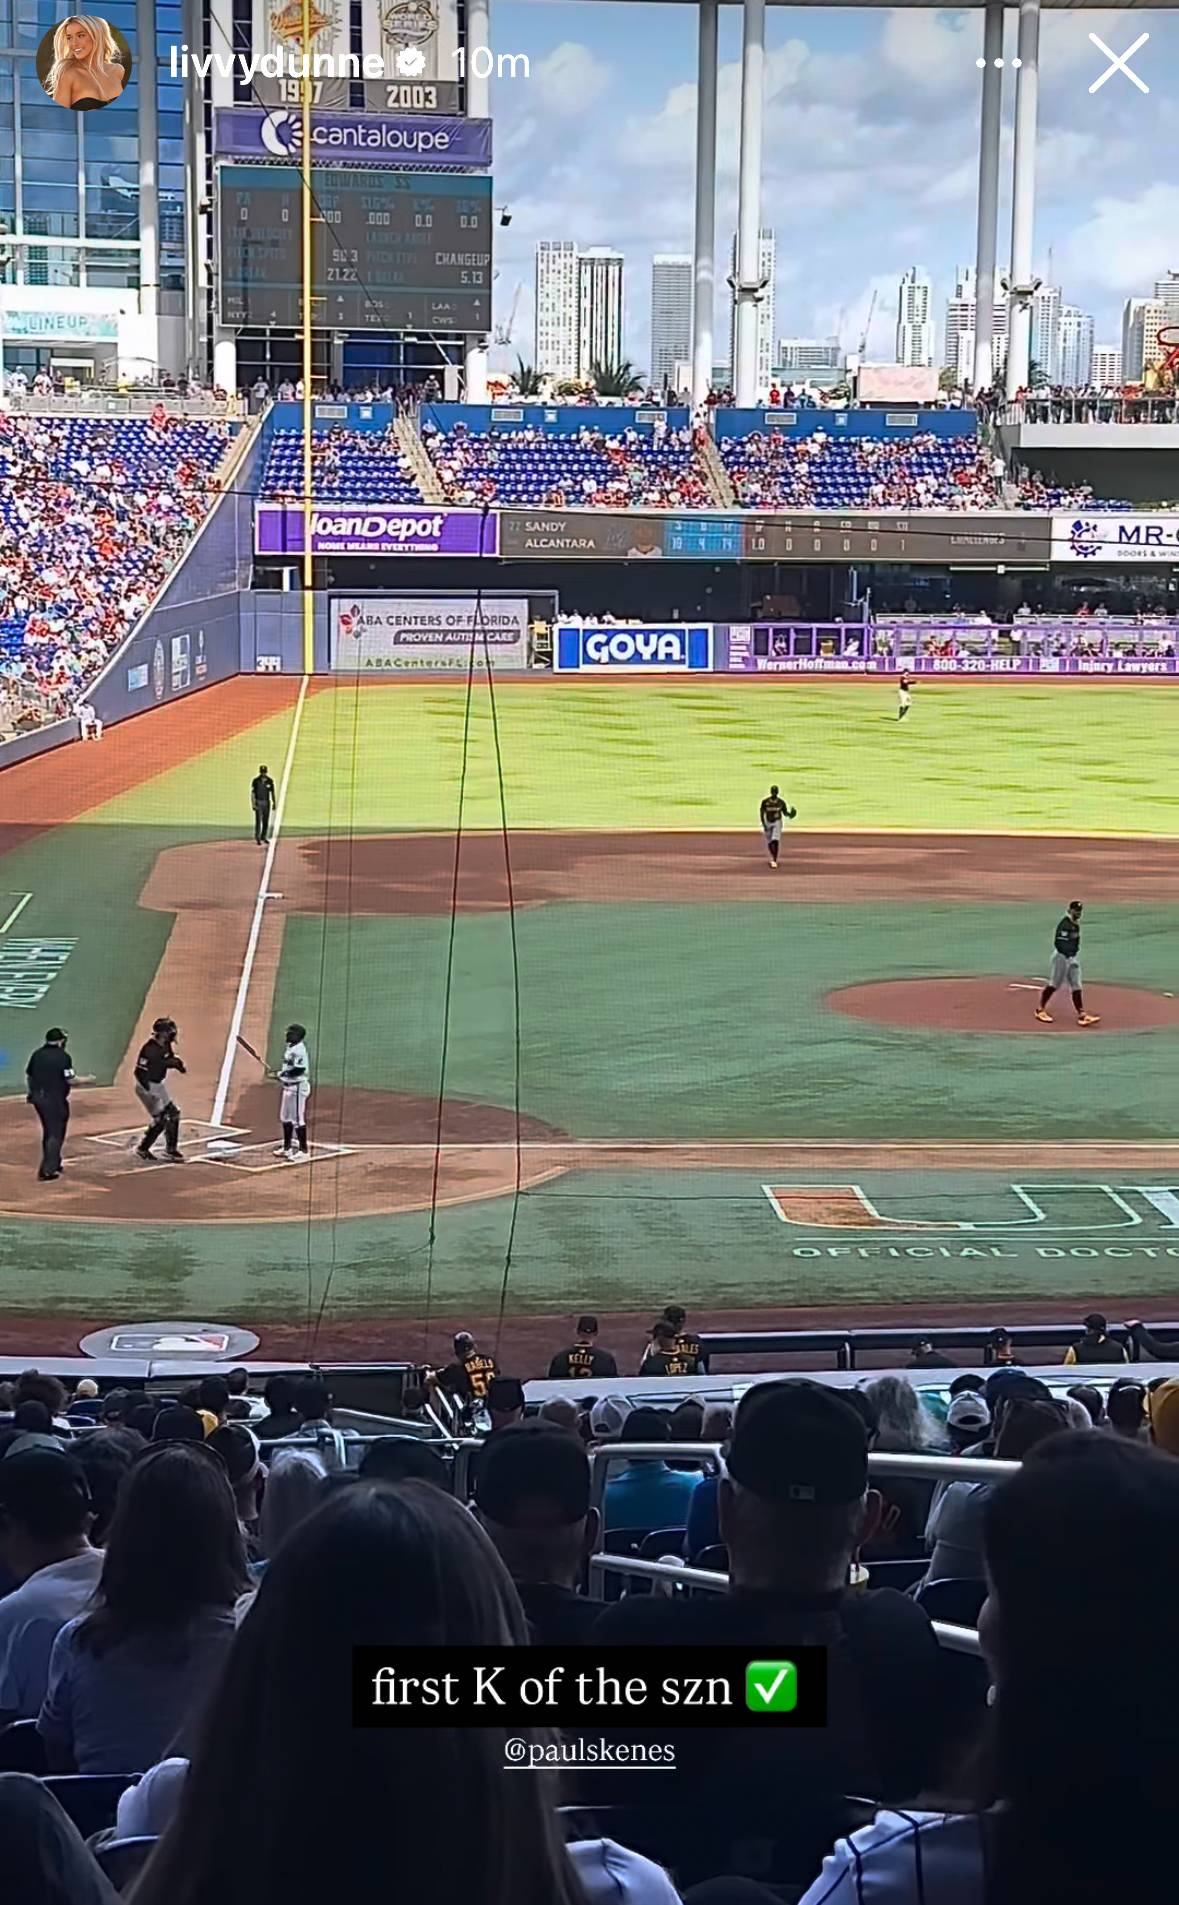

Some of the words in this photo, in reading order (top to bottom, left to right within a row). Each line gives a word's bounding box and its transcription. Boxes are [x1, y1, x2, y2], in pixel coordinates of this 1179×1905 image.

[387, 85, 437, 109] 2003
[313, 124, 450, 152] cantaloupe
[240, 207, 248, 220] 0
[281, 208, 289, 222] 0
[415, 214, 433, 227] 0.0
[460, 215, 478, 229] 0.0
[435, 252, 490, 266] CHANGEUP
[461, 271, 483, 284] 5.13
[311, 513, 444, 541] loanDepot
[525, 522, 566, 532] SANDY
[1119, 525, 1179, 544] MR-
[525, 539, 596, 548] ALCANTARA
[357, 616, 382, 626] ABA
[386, 616, 442, 626] CENTERS
[446, 616, 462, 626] OF
[467, 616, 519, 626] FLORIDA
[400, 632, 444, 642] PROVEN
[445, 632, 485, 642] AUTISM
[585, 633, 681, 664] GOYA
[757, 658, 877, 671] WernerHoffman.com
[933, 658, 1022, 671] 800-320-HELP
[1079, 659, 1112, 673] Injury
[1116, 659, 1168, 673] Lawyers
[793, 1247, 1018, 1258] OFFICIAL
[569, 1353, 594, 1365] KELLY
